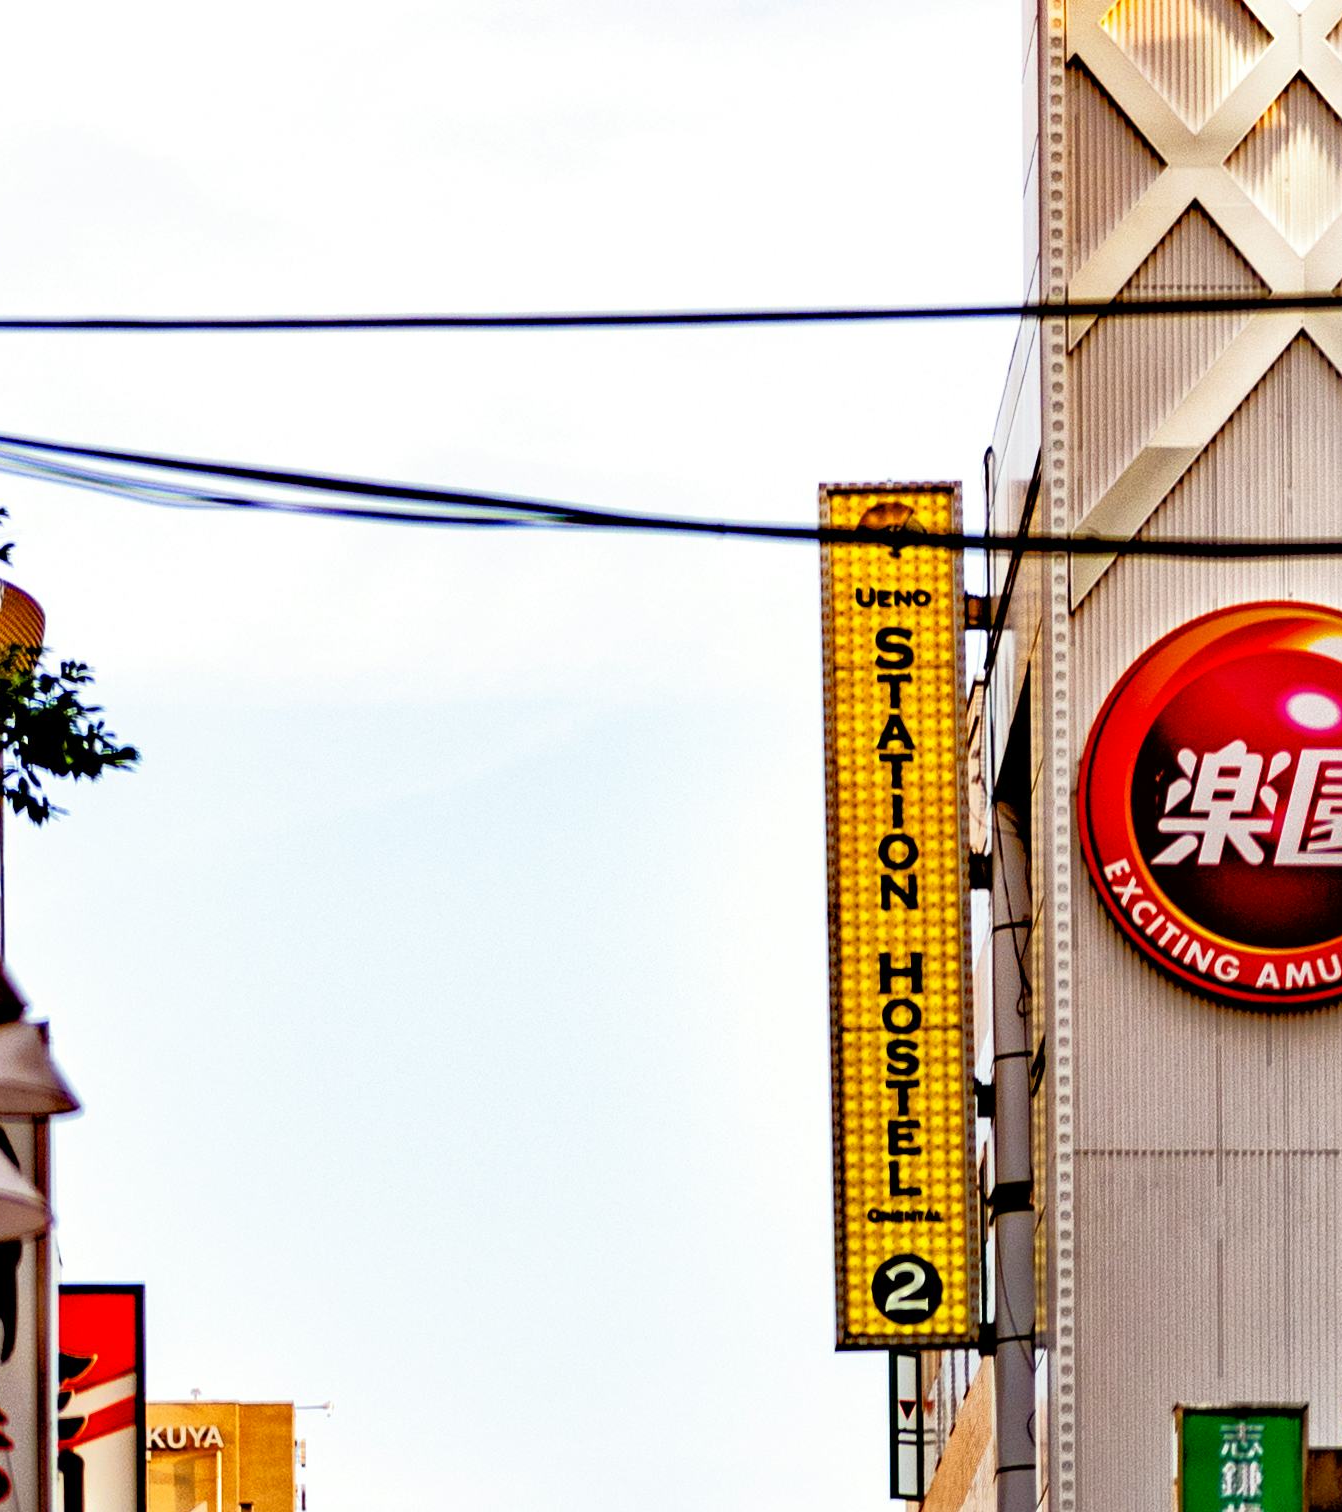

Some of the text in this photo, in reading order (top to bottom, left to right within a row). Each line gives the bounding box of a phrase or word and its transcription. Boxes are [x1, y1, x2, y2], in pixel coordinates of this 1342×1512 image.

[855, 590, 931, 608] UENO
[873, 626, 926, 1197] STATION HOSTEL
[1103, 856, 1241, 986] EXCITING
[884, 1263, 930, 1314] 2
